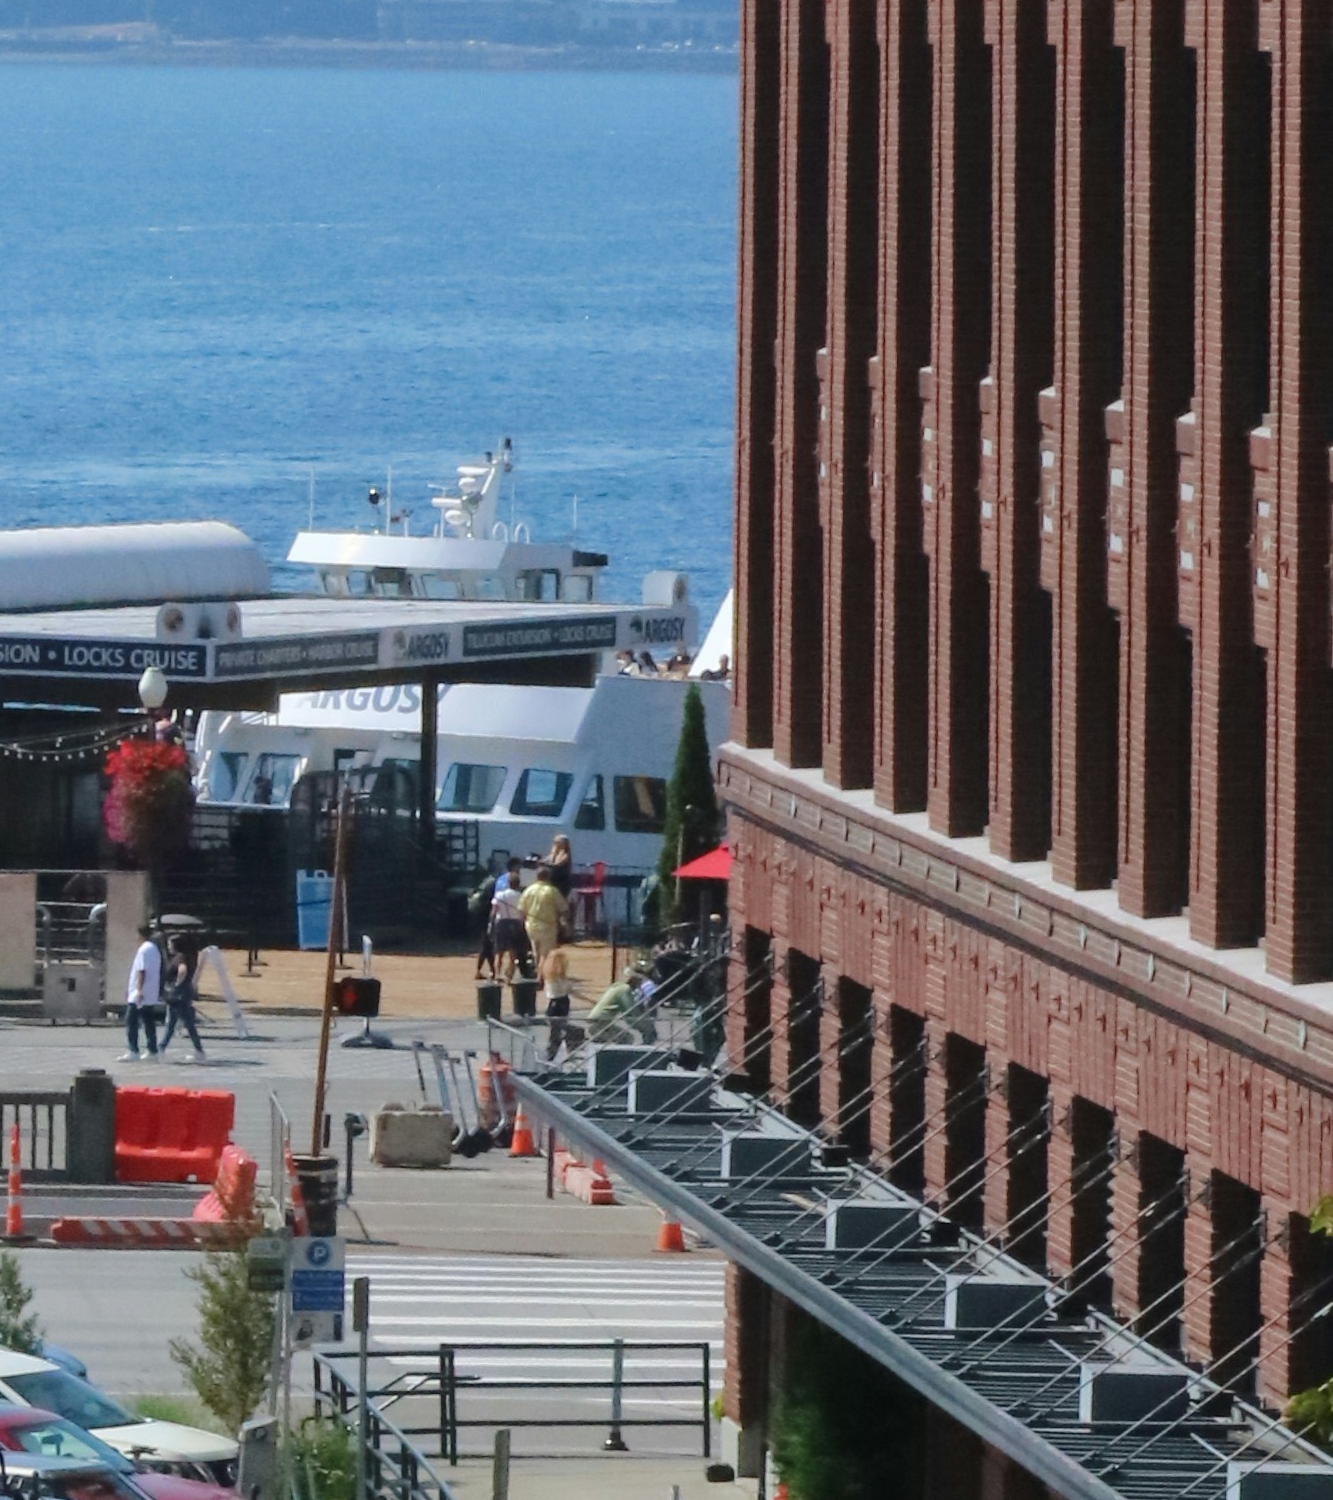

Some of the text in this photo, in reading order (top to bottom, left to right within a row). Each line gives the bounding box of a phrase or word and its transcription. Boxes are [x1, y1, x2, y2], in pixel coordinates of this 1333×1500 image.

[644, 617, 686, 643] ARGOSY
[63, 644, 126, 668] LOCKS
[129, 648, 199, 671] CRUISE
[407, 631, 450, 659] ARGOSY
[313, 1245, 327, 1261] P
